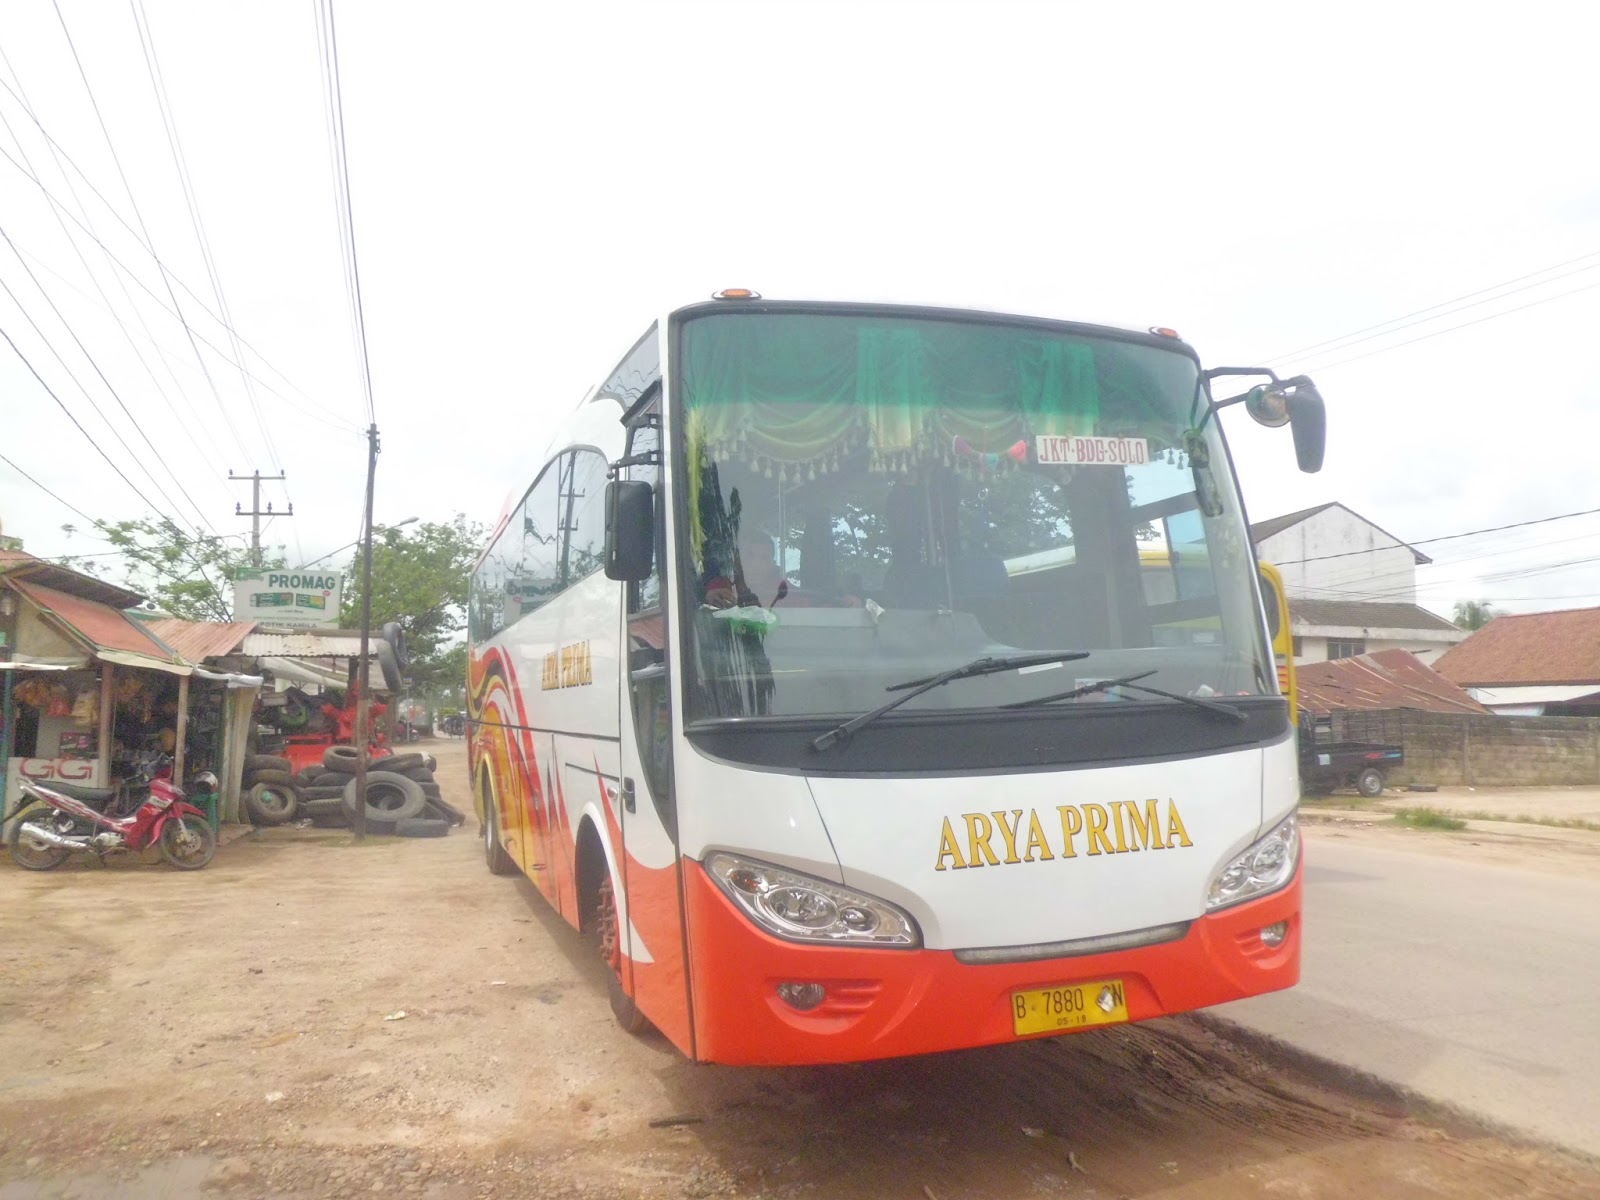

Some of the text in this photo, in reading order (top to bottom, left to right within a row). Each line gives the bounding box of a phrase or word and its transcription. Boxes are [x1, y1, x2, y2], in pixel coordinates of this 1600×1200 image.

[268, 574, 335, 590] PROMAG
[935, 797, 1194, 871] ARYA PRIMA
[1015, 994, 1026, 1018] B
[1042, 988, 1084, 1015] 7880
